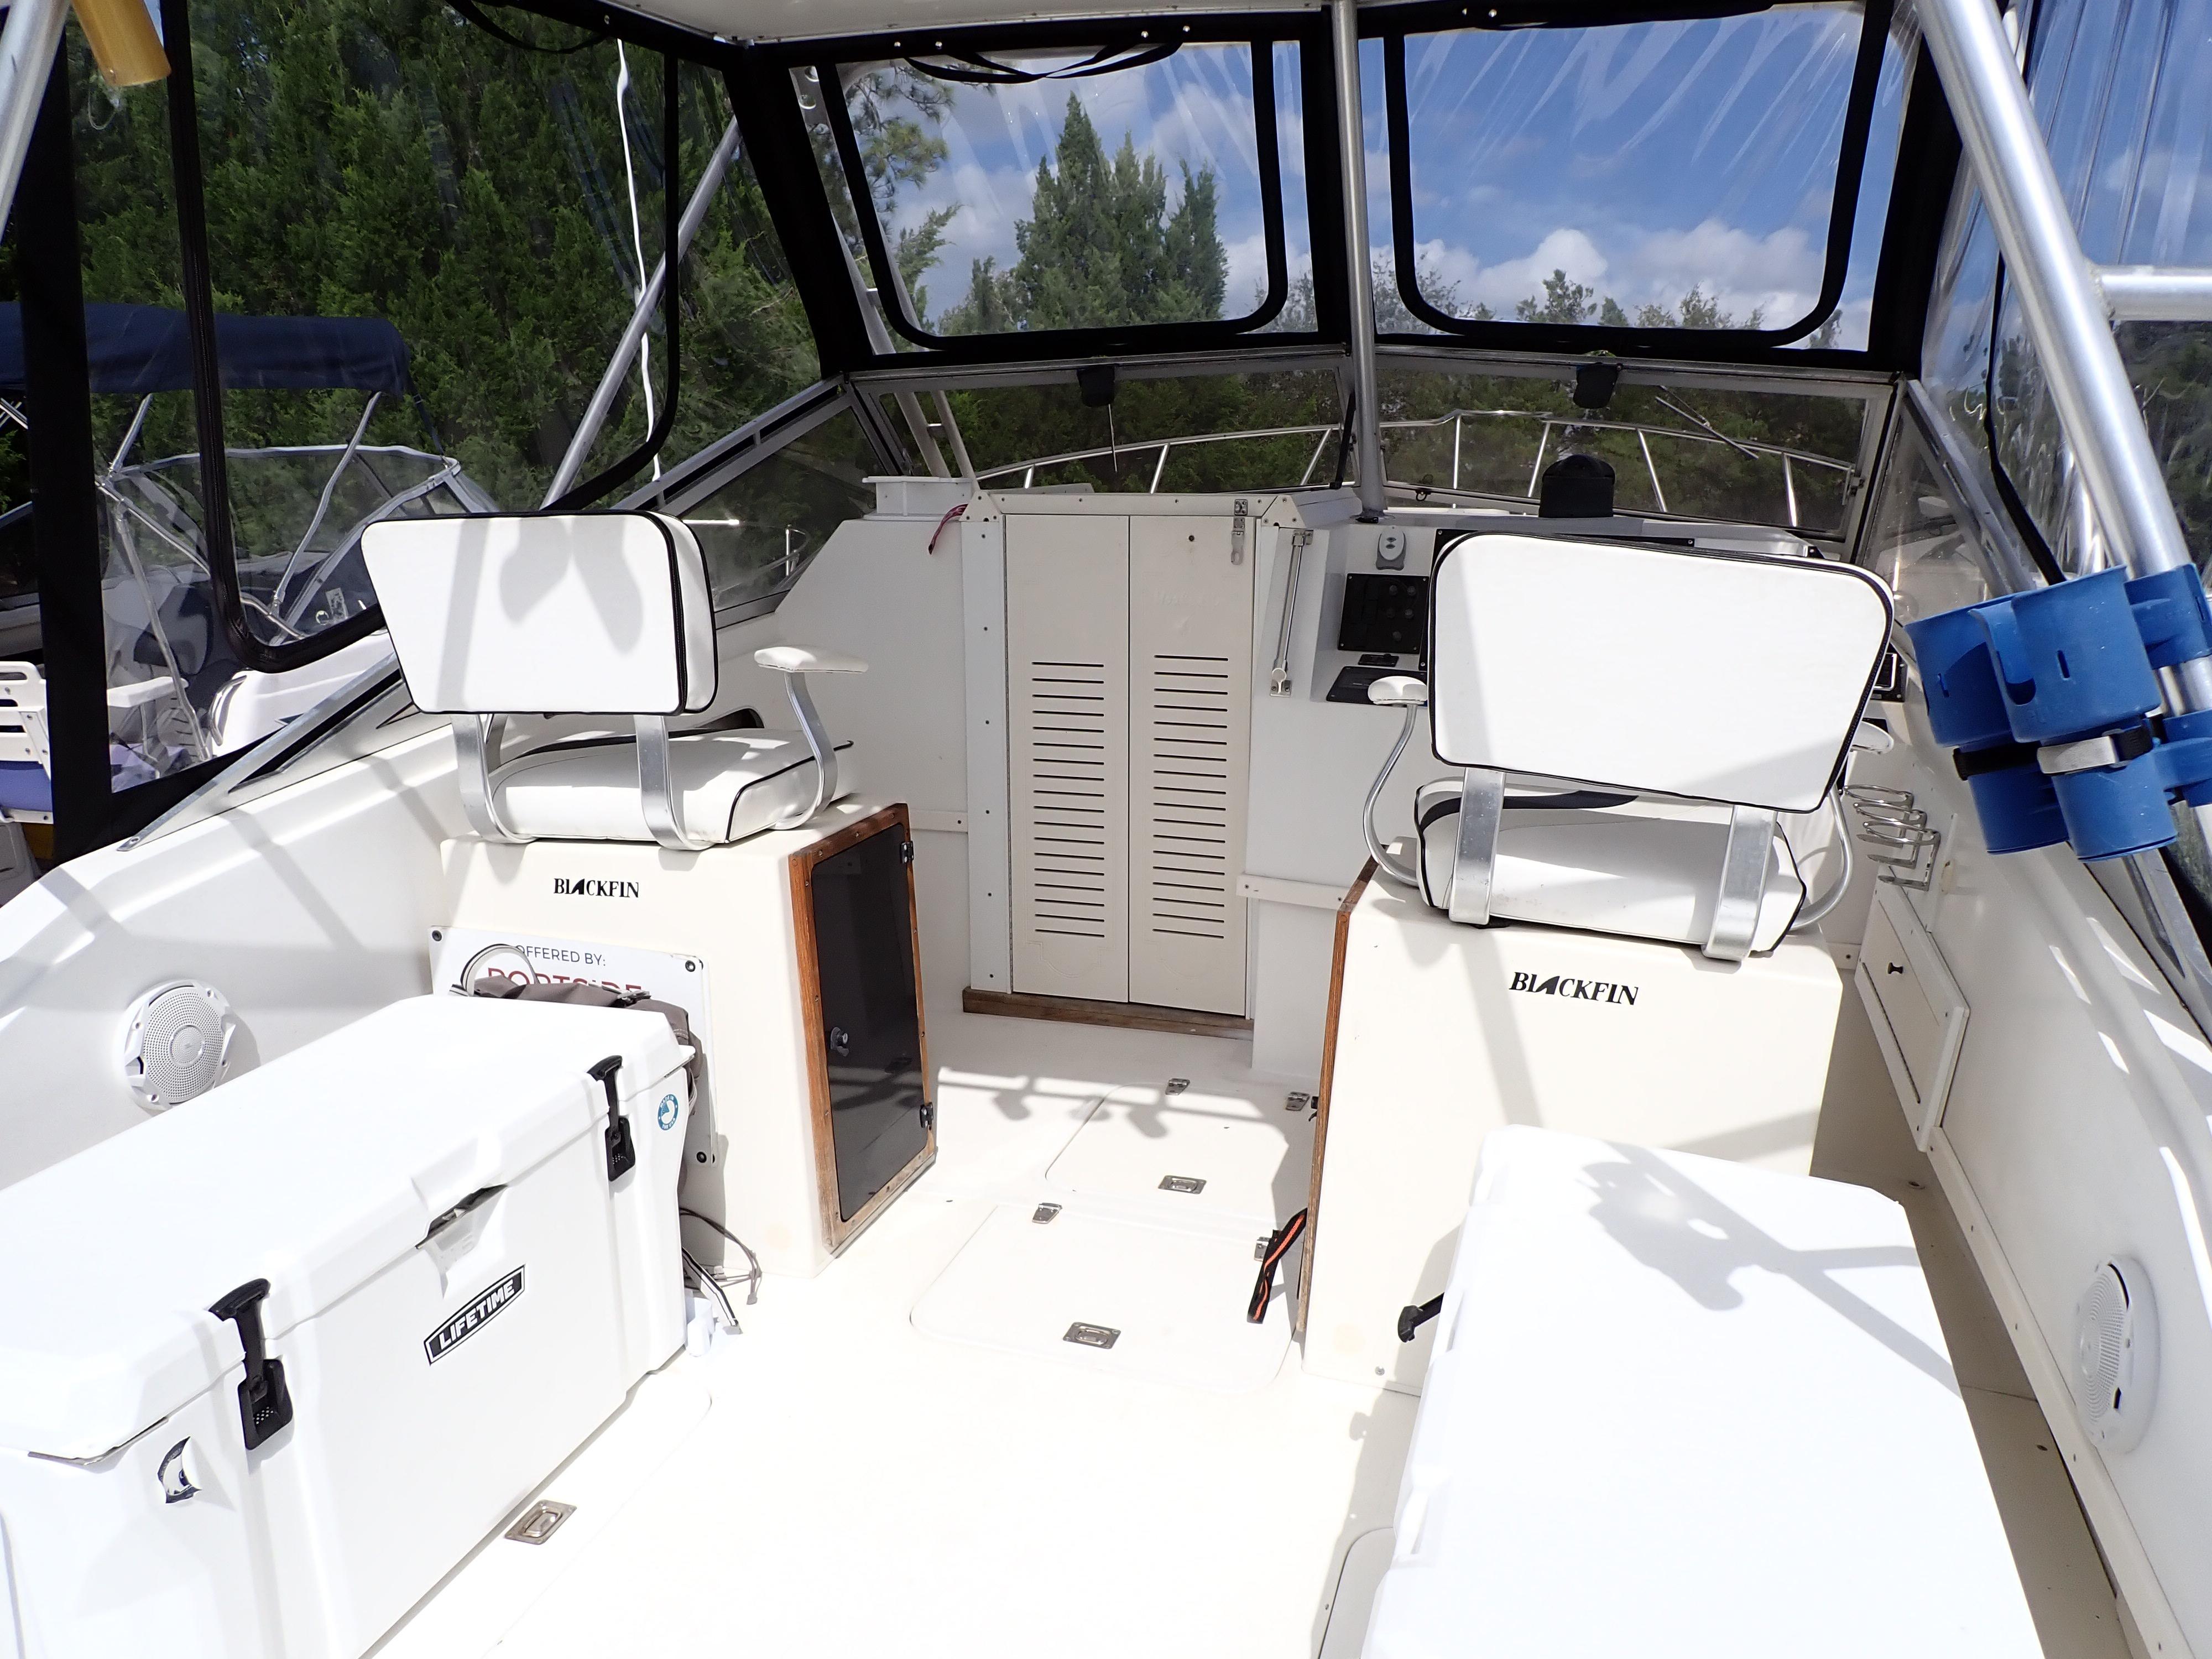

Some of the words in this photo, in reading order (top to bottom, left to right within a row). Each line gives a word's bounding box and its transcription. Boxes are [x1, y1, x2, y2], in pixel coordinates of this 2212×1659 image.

[553, 878, 639, 898] BLACKFIN
[585, 953, 606, 966] BY:
[1509, 972, 1639, 1005] BLACKFIN
[439, 1279, 514, 1349] LIFETIME
